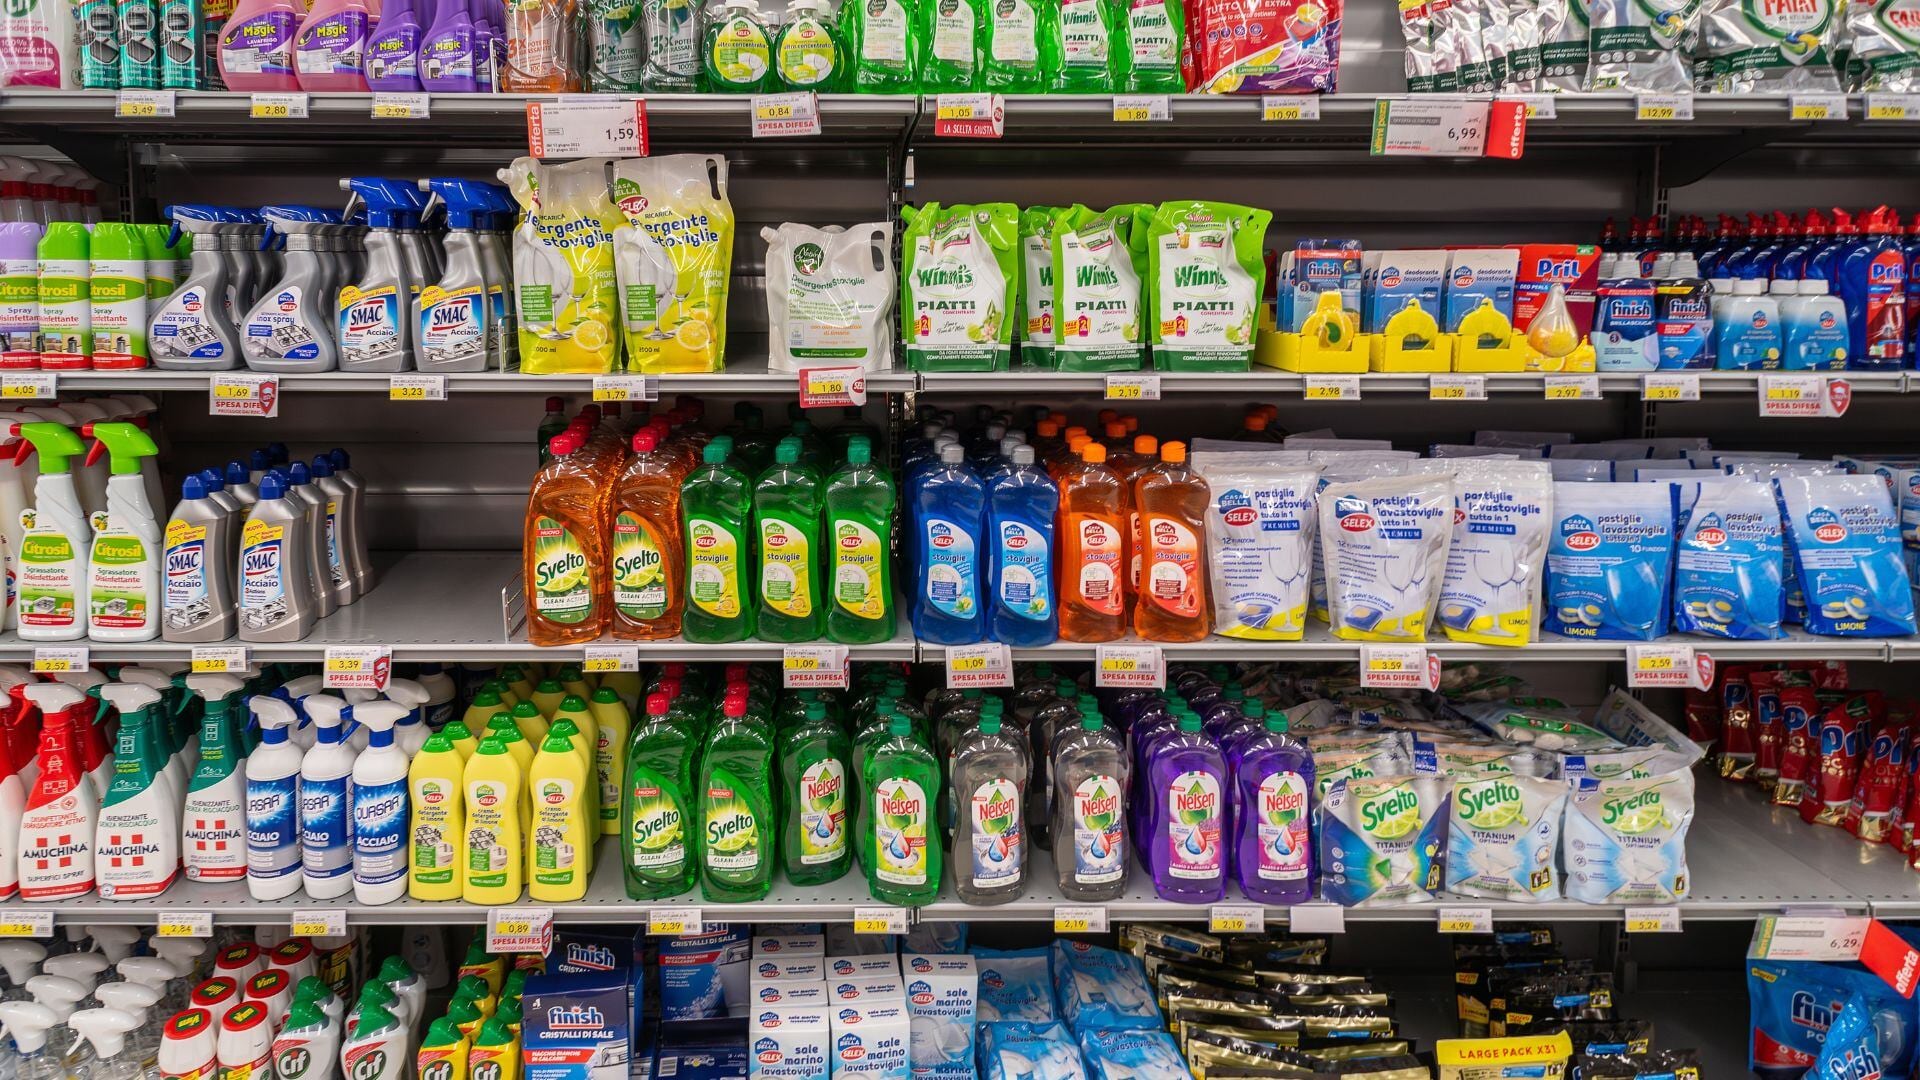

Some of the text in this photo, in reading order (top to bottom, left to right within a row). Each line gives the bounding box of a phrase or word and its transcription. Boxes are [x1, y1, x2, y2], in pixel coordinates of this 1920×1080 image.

[1063, 11, 1097, 25] Winni's
[1132, 14, 1167, 28] Winni's
[243, 23, 276, 37] Magic
[316, 23, 347, 38] Magic
[1065, 34, 1099, 42] PIATTI
[1134, 37, 1168, 45] PIATTI
[379, 40, 404, 51] Magic
[435, 40, 461, 51] Magic
[132, 106, 153, 115] 3,49
[265, 106, 286, 115] 2,80
[385, 108, 407, 116] 2,99
[769, 107, 789, 116] 0,84
[950, 109, 970, 118] 1,05
[1127, 110, 1148, 120] 1,80
[1271, 110, 1298, 119] 10,90
[1648, 108, 1673, 118] 12,99
[1805, 110, 1825, 119] 9,99
[1881, 106, 1902, 116] 5,99
[532, 106, 541, 155] offerta
[605, 128, 634, 141] 1,59
[943, 125, 993, 135] LA SCELTA GIUSTA
[1448, 128, 1477, 139] 6,99
[1511, 104, 1523, 156] offerta
[543, 229, 614, 249] stoviglie
[1307, 262, 1341, 275] finish
[1537, 260, 1582, 278] Pril
[1871, 263, 1905, 279] Pril
[918, 263, 974, 289] Winni's
[1076, 265, 1118, 289] Winni's
[1174, 267, 1228, 288] Winni's
[791, 274, 865, 290] Detergente Stoviglie
[917, 300, 976, 311] PIATTI
[1075, 301, 1127, 311] PIATTI
[1173, 301, 1234, 311] PIATTI
[1610, 301, 1650, 315] finish
[1669, 300, 1706, 313] finish
[351, 305, 383, 325] SMAC
[434, 305, 467, 324] SMAC
[14, 385, 34, 394] 4,05
[228, 388, 248, 397] 1,69
[402, 388, 422, 396] 3,23
[822, 383, 841, 393] 1,80
[1119, 388, 1138, 398] 2,19
[1319, 387, 1340, 395] 2,98
[1444, 389, 1463, 397] 1,39
[1556, 389, 1577, 397] 2,97
[606, 391, 626, 399] 1,79
[1659, 390, 1679, 399] 3,19
[1781, 390, 1800, 399] 1,19
[1373, 496, 1420, 507] pastiglie
[1464, 491, 1513, 502] pastiglie
[1377, 508, 1444, 518] lavastoviglie
[1469, 502, 1541, 514] lavastoviglie
[1227, 511, 1258, 522] SELEX
[1341, 517, 1374, 528] SELEX
[1469, 524, 1514, 533] PREMIUM
[1567, 535, 1599, 546] SELEX
[23, 542, 69, 556] Citrosil
[96, 542, 141, 557] Citrosil
[169, 553, 199, 570] SMAC
[246, 553, 275, 570] SMAC
[695, 553, 729, 563] stoviglie
[840, 554, 874, 563] stoviglie
[932, 553, 966, 563] stoviglie
[1156, 552, 1190, 561] stoviglie
[25, 566, 65, 574] Sgrassatore
[536, 552, 584, 587] Svelto
[615, 553, 660, 583] Svelto
[23, 573, 69, 581] Disinfettante
[167, 579, 201, 588] Acciaio
[245, 579, 278, 588] Acciaio
[543, 595, 587, 605] CLEAN ACTIVE
[1834, 621, 1866, 631] LIMONE
[1564, 627, 1597, 637] LIMONE
[45, 662, 65, 670] 2,52
[206, 659, 226, 668] 3,23
[339, 660, 359, 669] 3,39
[597, 661, 617, 670] 2,39
[794, 659, 814, 668] 1,09
[964, 659, 984, 668] 1,09
[1114, 661, 1134, 669] 1,09
[1382, 661, 1402, 670] 3,59
[1650, 659, 1671, 668] 2,59
[952, 673, 976, 681] SPESA
[808, 775, 841, 799] Nelsen
[1177, 792, 1215, 810] Nelsen
[1266, 792, 1303, 810] Nelsen
[1458, 781, 1520, 819] Svelto
[882, 798, 919, 815] Nelsen
[979, 799, 1015, 819] Nelsen
[1081, 795, 1117, 816] Nelsen
[1362, 789, 1418, 831] Svelto
[1602, 791, 1661, 824] Svelto
[634, 809, 680, 844] Svelto
[708, 813, 753, 844] Svelto
[184, 829, 241, 840] AMUCHINA
[356, 833, 399, 846] ACCIAIO
[1471, 831, 1515, 840] TITANIUM
[1375, 841, 1413, 849] TITANIUM
[1617, 836, 1661, 845] TITANIUM
[23, 844, 88, 859] AMUCHINA
[98, 844, 160, 857] AMUCHINA
[713, 856, 733, 864] CLEAN
[508, 924, 528, 933] 0,89
[661, 922, 681, 930] 2,39
[866, 922, 887, 930] 2,19
[1064, 919, 1084, 928] 2,19
[1223, 921, 1242, 929] 2,19
[1451, 922, 1470, 930] 4,99
[1639, 921, 1658, 930] 5,24
[13, 925, 32, 933] 2,84
[171, 925, 191, 933] 2,84
[305, 925, 325, 934] 2,30
[1895, 951, 1920, 994] offerta
[256, 977, 276, 989] Vim
[549, 1006, 604, 1025] finish
[878, 1038, 900, 1048] sale
[795, 1045, 818, 1054] sale
[867, 1048, 905, 1060] marino
[1459, 1045, 1556, 1059] LARGE PACK X31
[280, 1052, 308, 1073] Cif
[784, 1056, 823, 1065] marino
[844, 1059, 904, 1072] lavastoviglie
[354, 1056, 383, 1078] Cif
[761, 1065, 823, 1077] lavastoviglie
